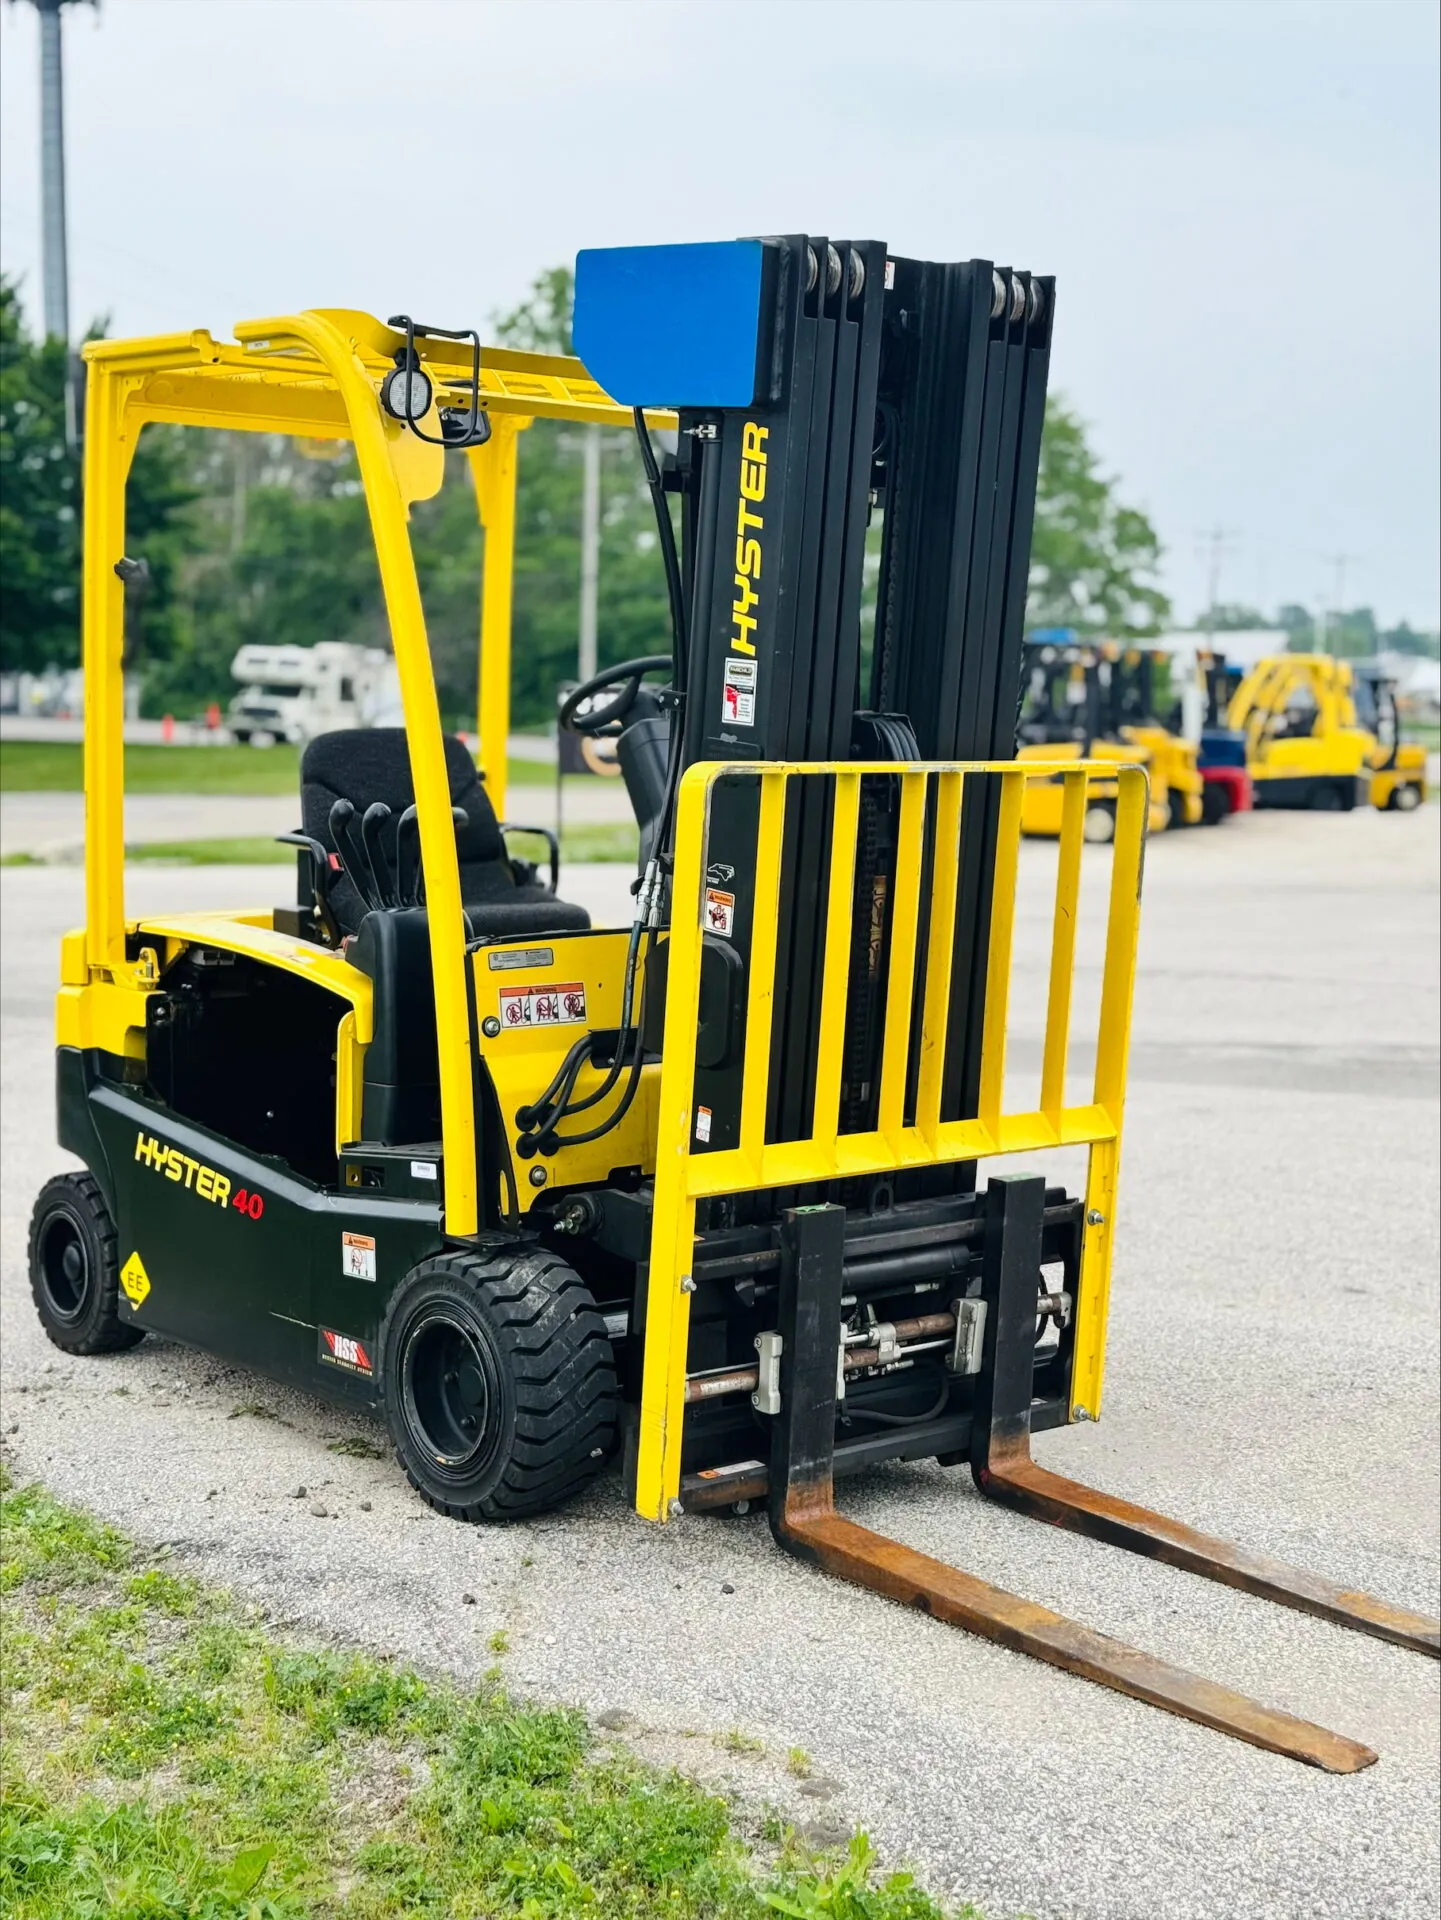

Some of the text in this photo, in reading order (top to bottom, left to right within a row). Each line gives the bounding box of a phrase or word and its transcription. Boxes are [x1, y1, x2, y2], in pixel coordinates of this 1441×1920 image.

[731, 421, 769, 656] HYSTER
[135, 1131, 264, 1220] HYSTER 40
[127, 1271, 144, 1292] EE
[334, 1334, 358, 1364] HSS
